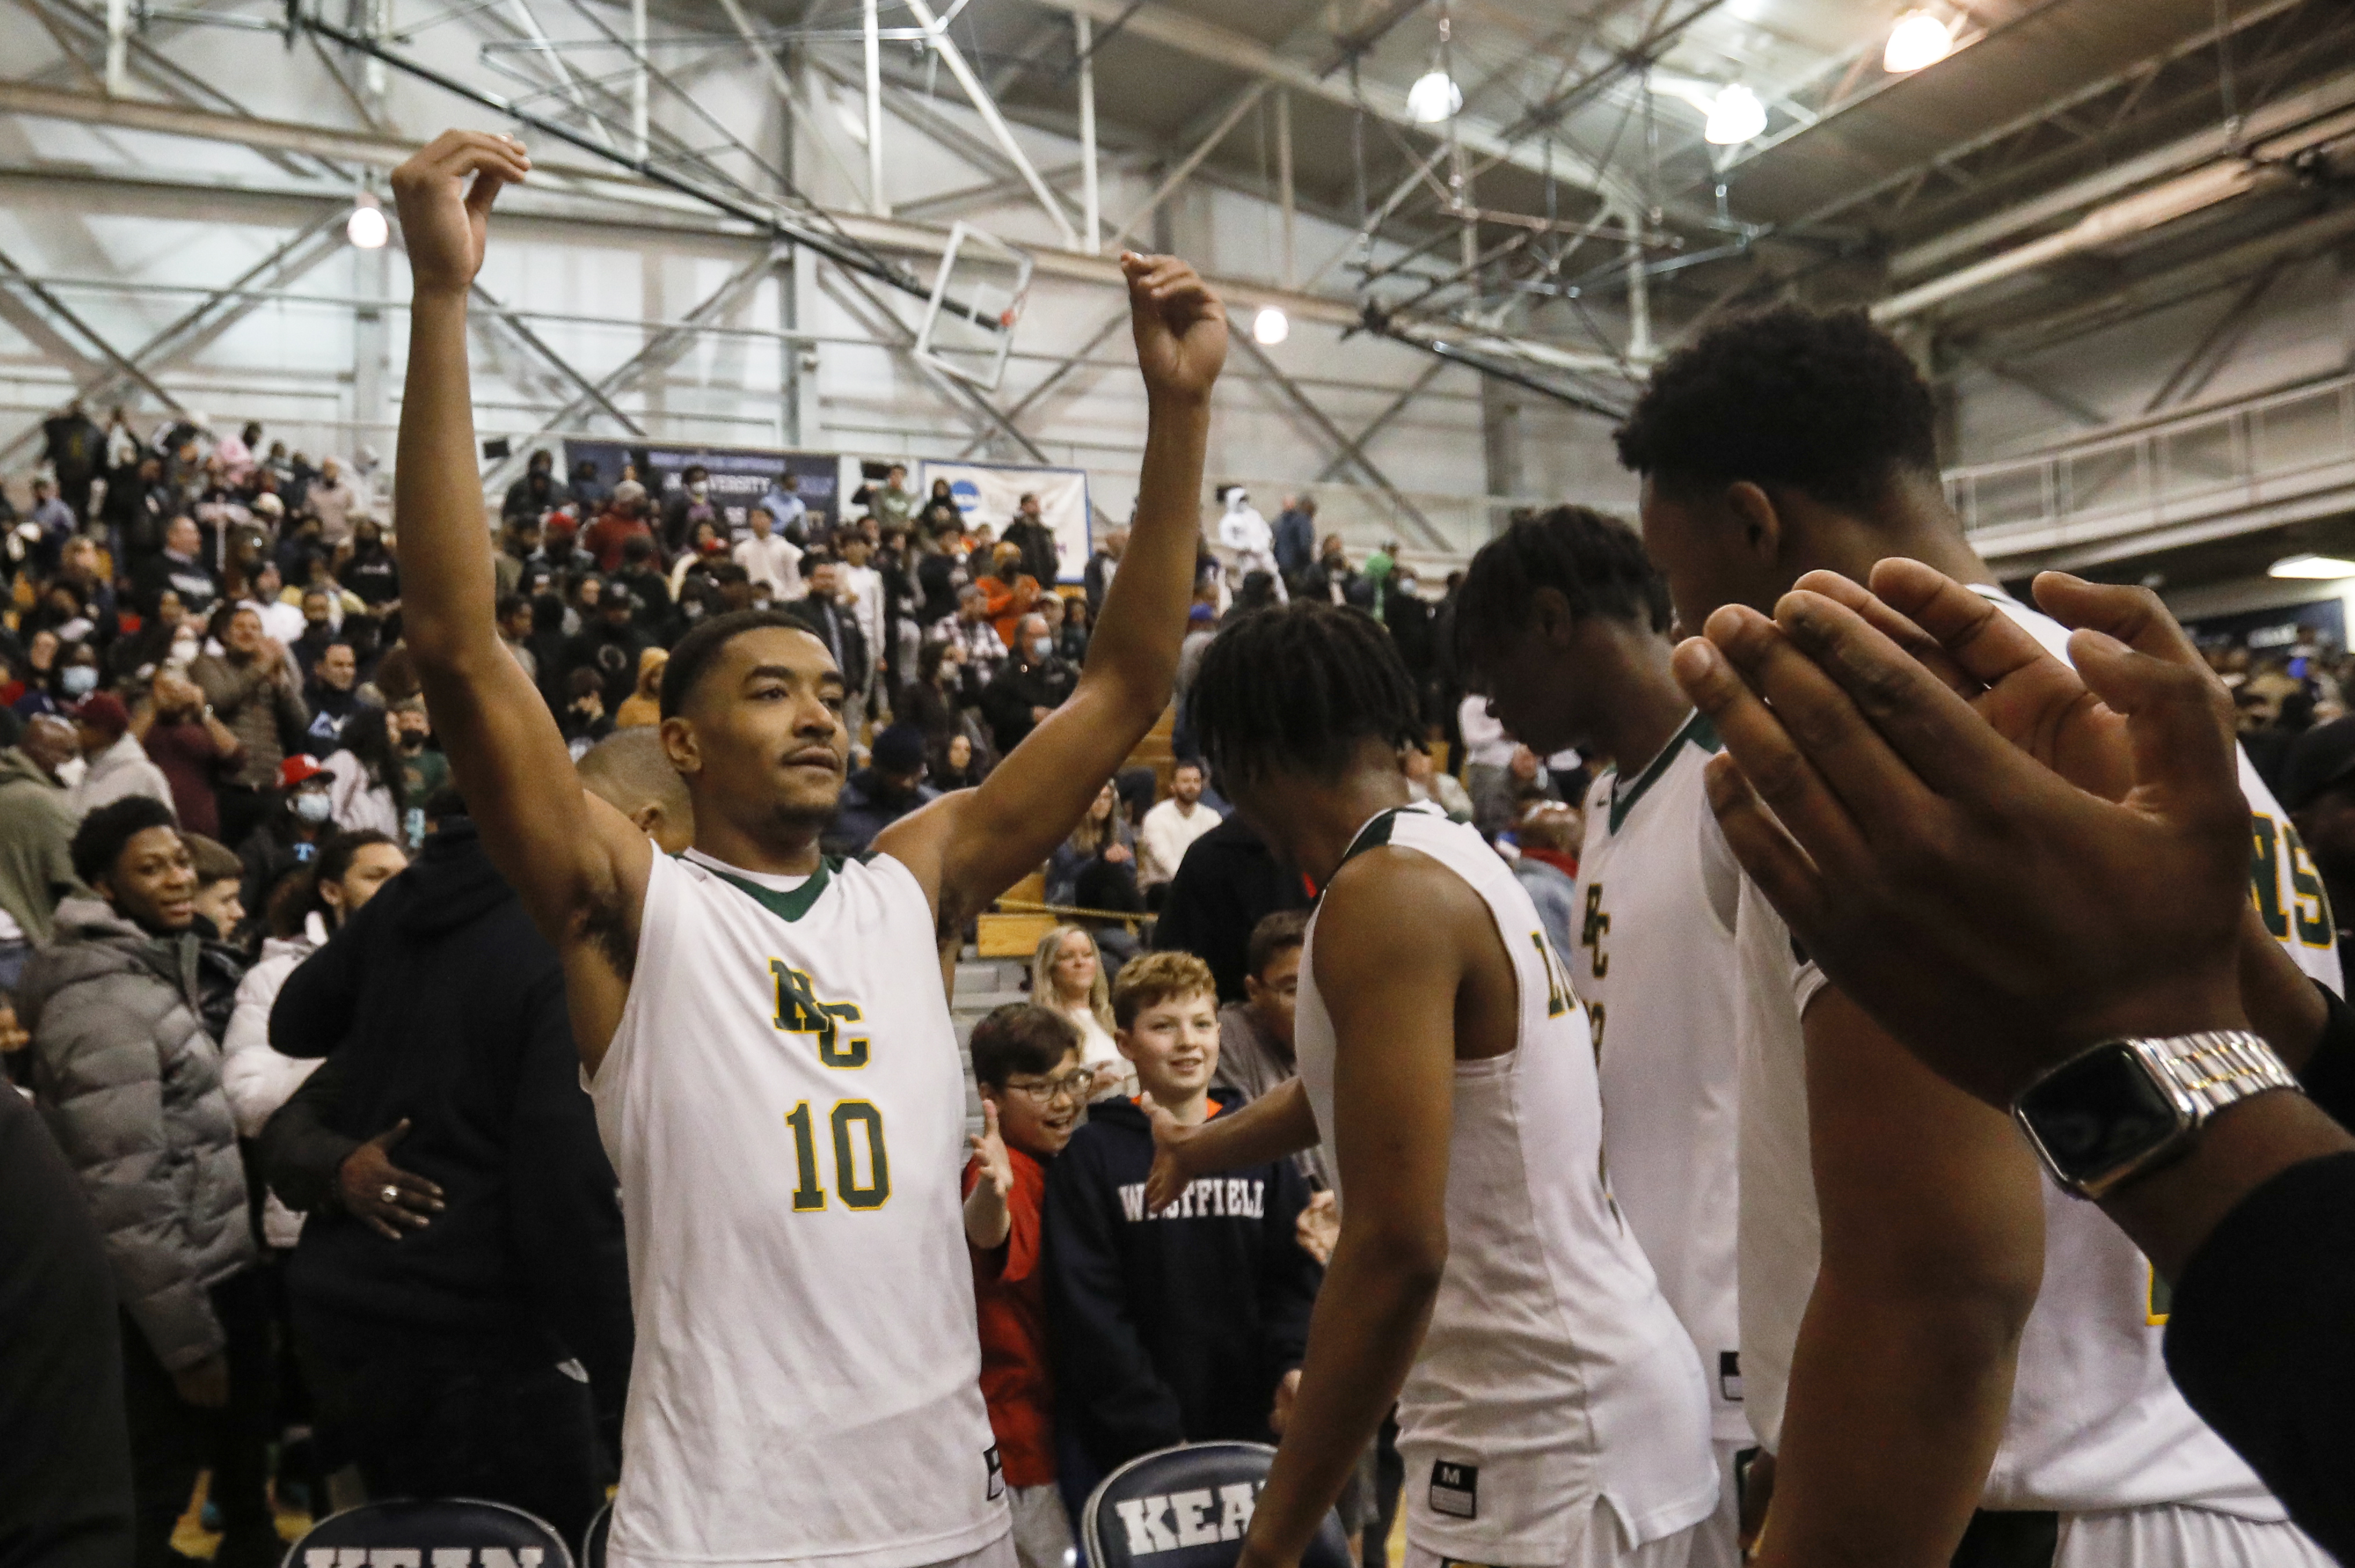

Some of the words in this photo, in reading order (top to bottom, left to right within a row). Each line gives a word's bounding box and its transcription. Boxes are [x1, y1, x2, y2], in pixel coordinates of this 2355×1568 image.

[784, 1098, 893, 1212] 10
[1117, 1178, 1265, 1222] WTFIEL
[1113, 1478, 1267, 1556] KEA
